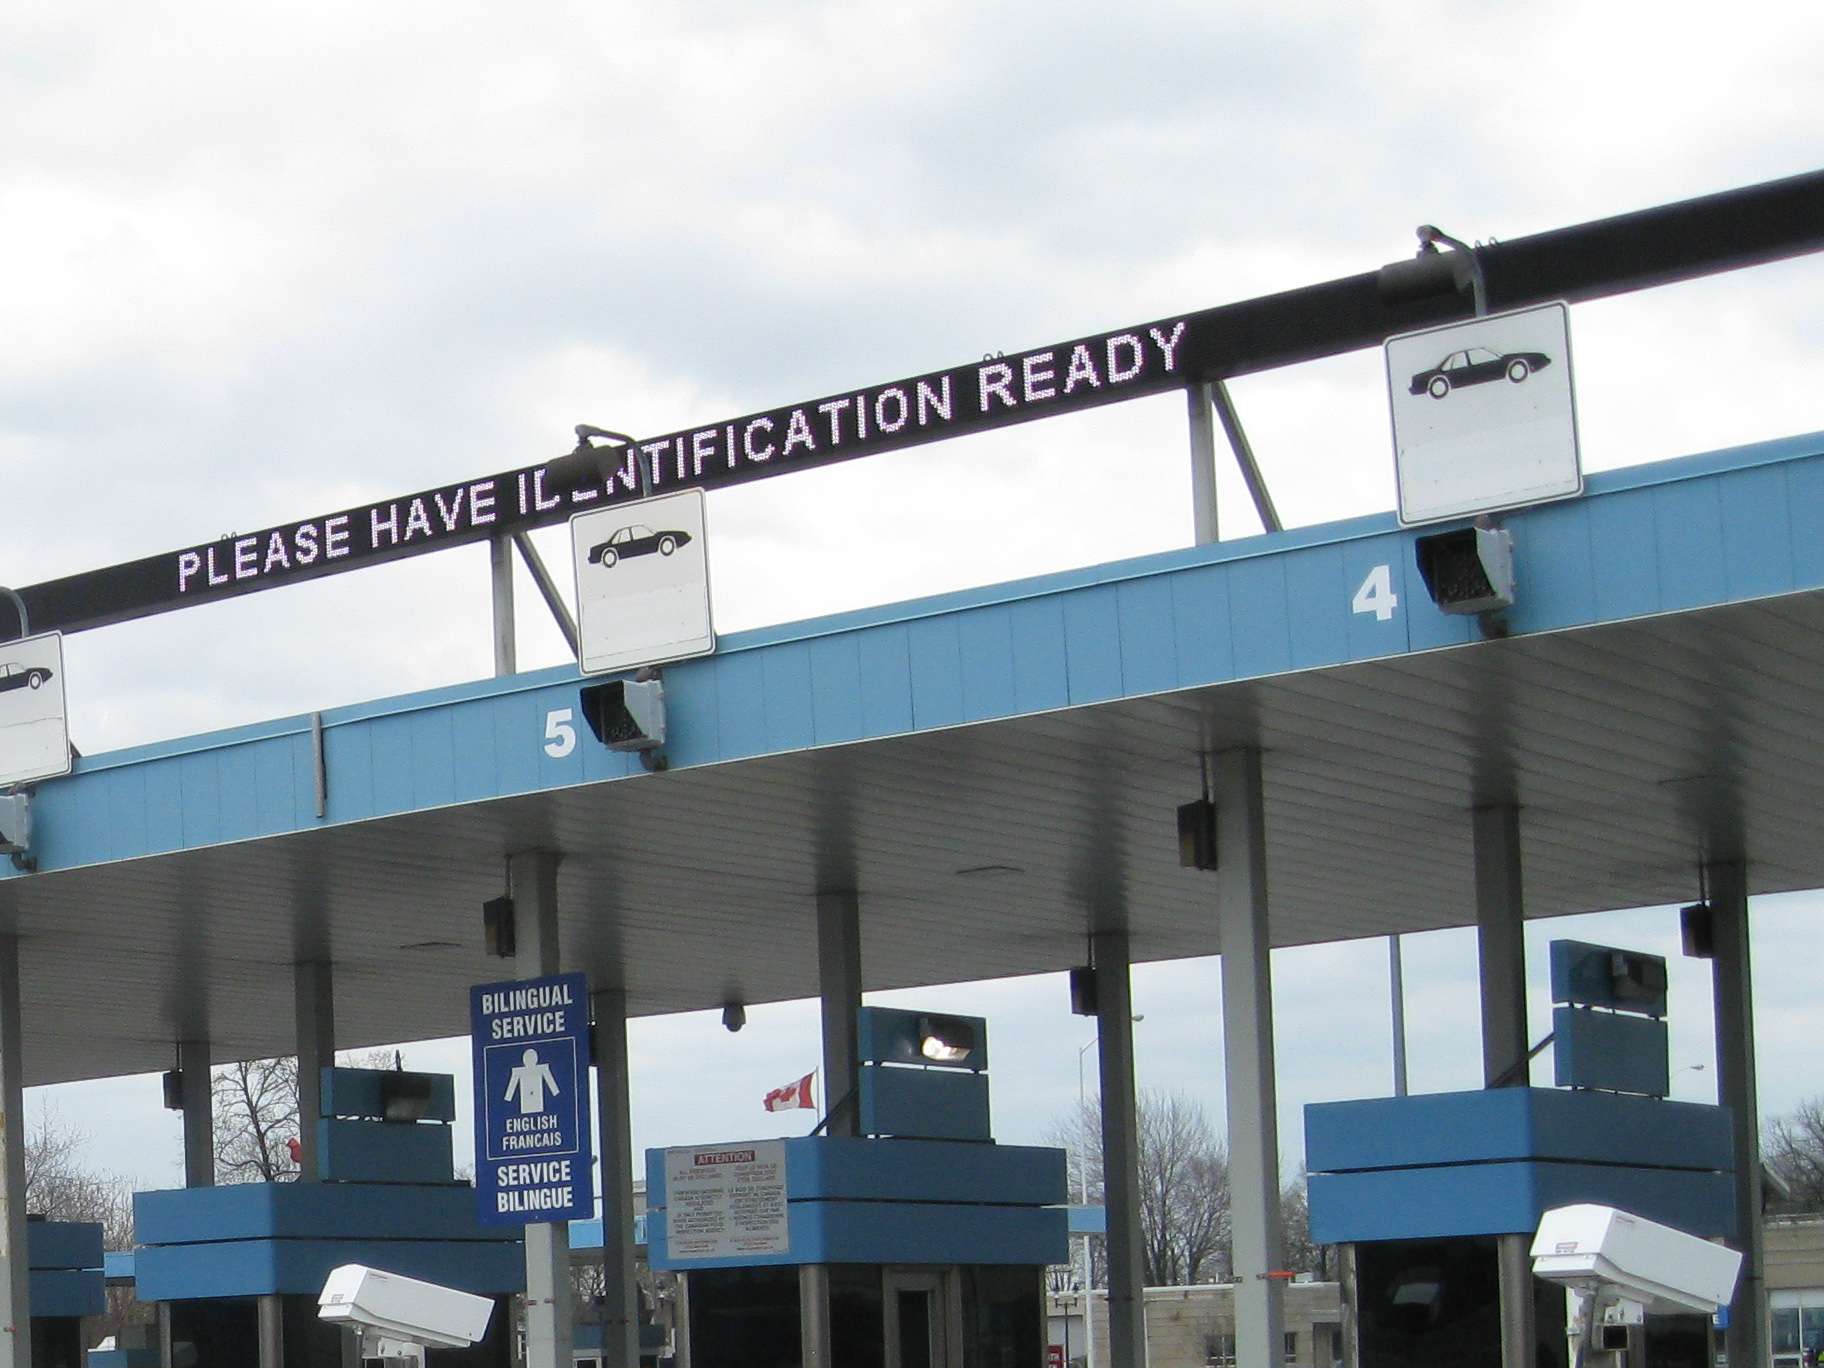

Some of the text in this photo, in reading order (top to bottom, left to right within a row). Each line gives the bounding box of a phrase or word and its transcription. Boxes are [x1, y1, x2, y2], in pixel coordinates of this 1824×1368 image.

[178, 321, 1185, 591] PLEASE HAVE IDNTIFICATION READY
[1352, 565, 1398, 621] 4
[544, 708, 576, 758] 5
[482, 984, 573, 1015] BILINGUAL
[491, 1011, 565, 1039] SERVICE
[506, 1115, 558, 1133] ENGLISH
[503, 1132, 562, 1151] FRANCAIS
[697, 1151, 753, 1165] ATTENTION
[497, 1160, 571, 1187] SERVICE
[497, 1187, 573, 1213] BILINGUE
